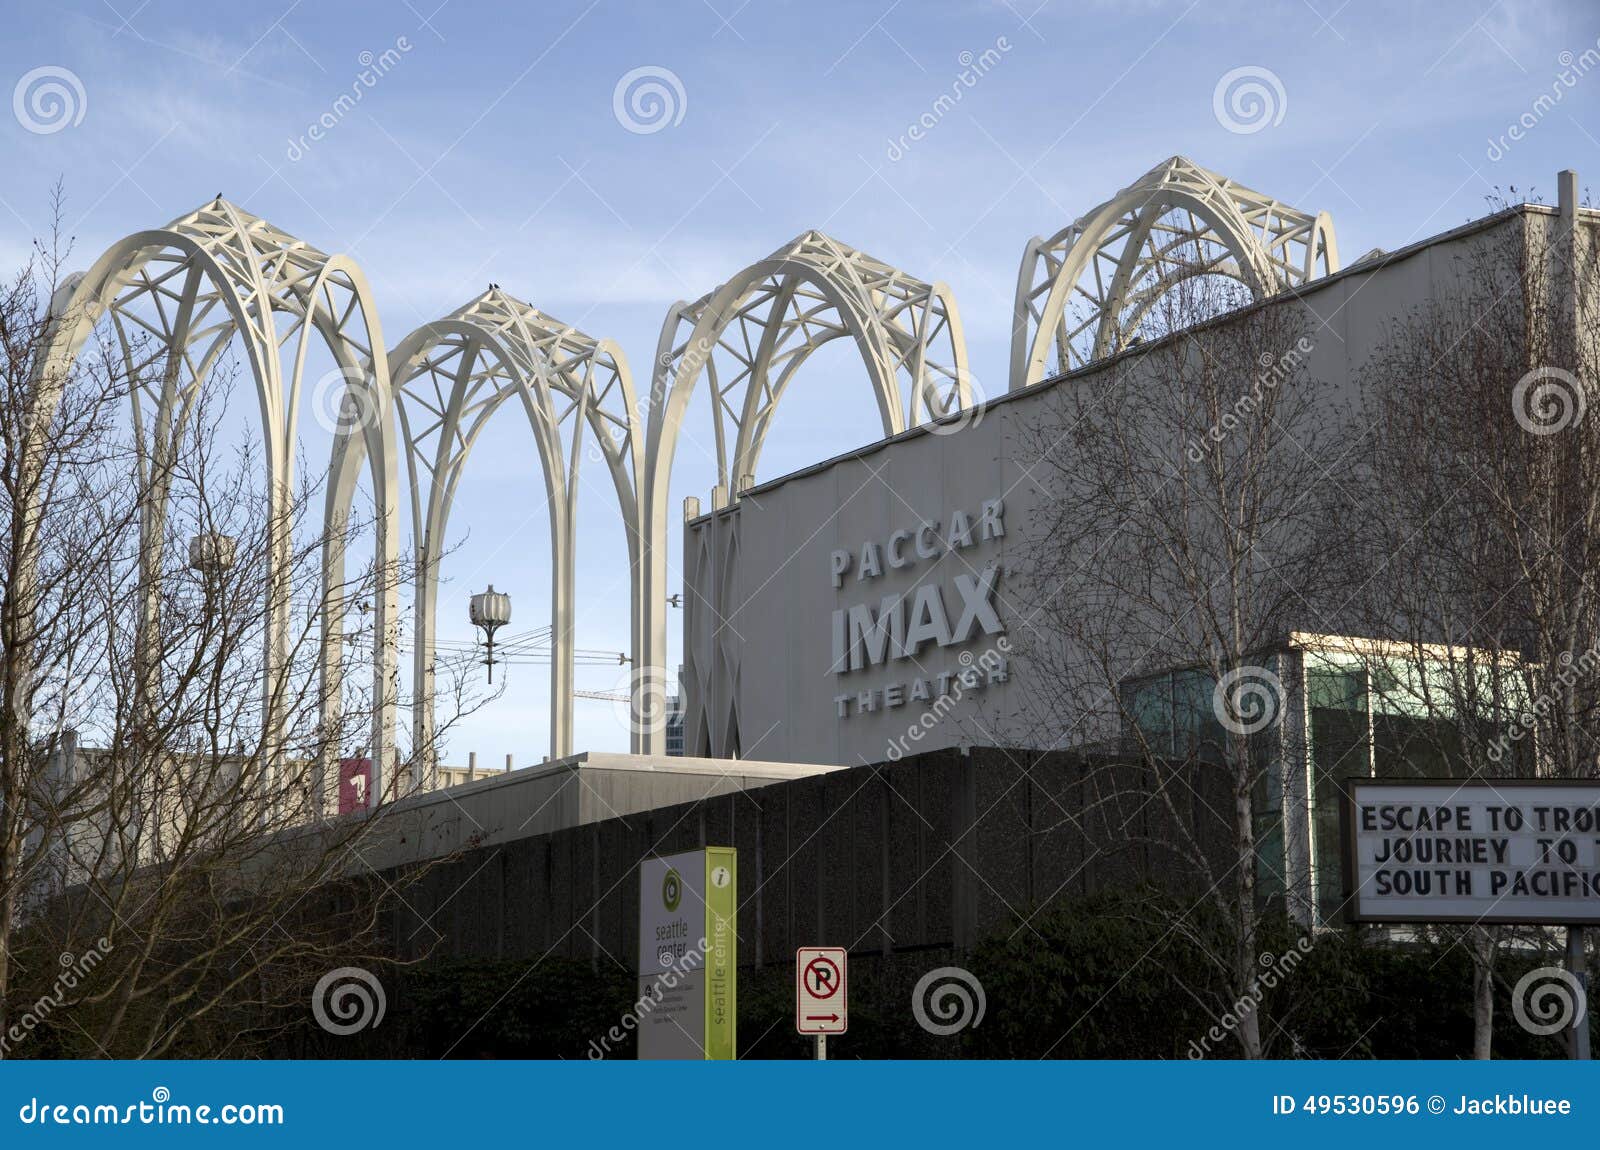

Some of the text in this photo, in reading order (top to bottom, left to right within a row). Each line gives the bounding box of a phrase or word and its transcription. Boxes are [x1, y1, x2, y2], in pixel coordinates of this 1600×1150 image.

[831, 499, 1006, 590] PACCAR
[831, 560, 1006, 674] IMAX
[834, 659, 1010, 718] THEATER
[1361, 806, 1473, 832] ESCAPE
[1486, 806, 1524, 832] TO
[1374, 838, 1578, 865] JOURNEY TO
[1375, 870, 1472, 896] SOUTH
[655, 917, 688, 941] seattle
[657, 941, 688, 961] center
